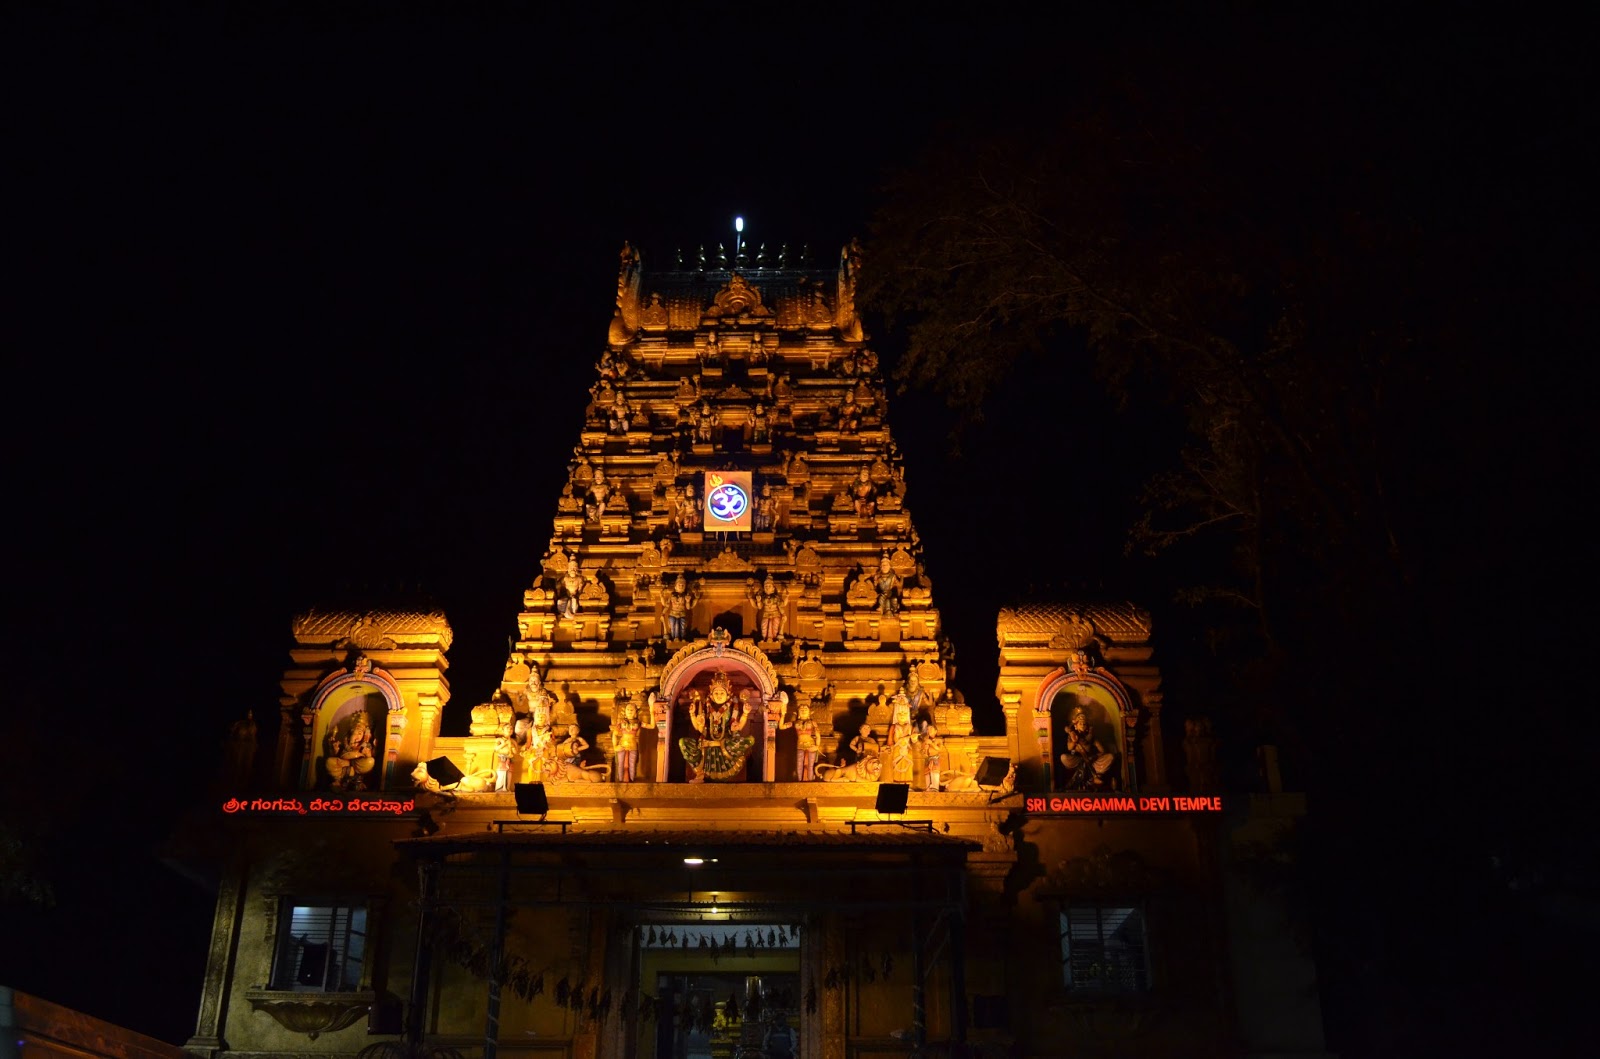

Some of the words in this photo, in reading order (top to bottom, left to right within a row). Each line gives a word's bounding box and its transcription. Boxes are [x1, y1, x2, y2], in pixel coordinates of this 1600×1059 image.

[222, 797, 248, 813] ಶ್ರೀ
[250, 798, 308, 815] ಗಂಗಮ್ಮ
[309, 798, 344, 811] ದೇವಿ
[347, 798, 415, 815] ದೇವಸ್ಥಾನ
[1026, 797, 1047, 812] SRI
[1050, 797, 1137, 812] GANGAMMA
[1139, 797, 1171, 812] DEVI
[1172, 796, 1222, 811] TEMPLE
